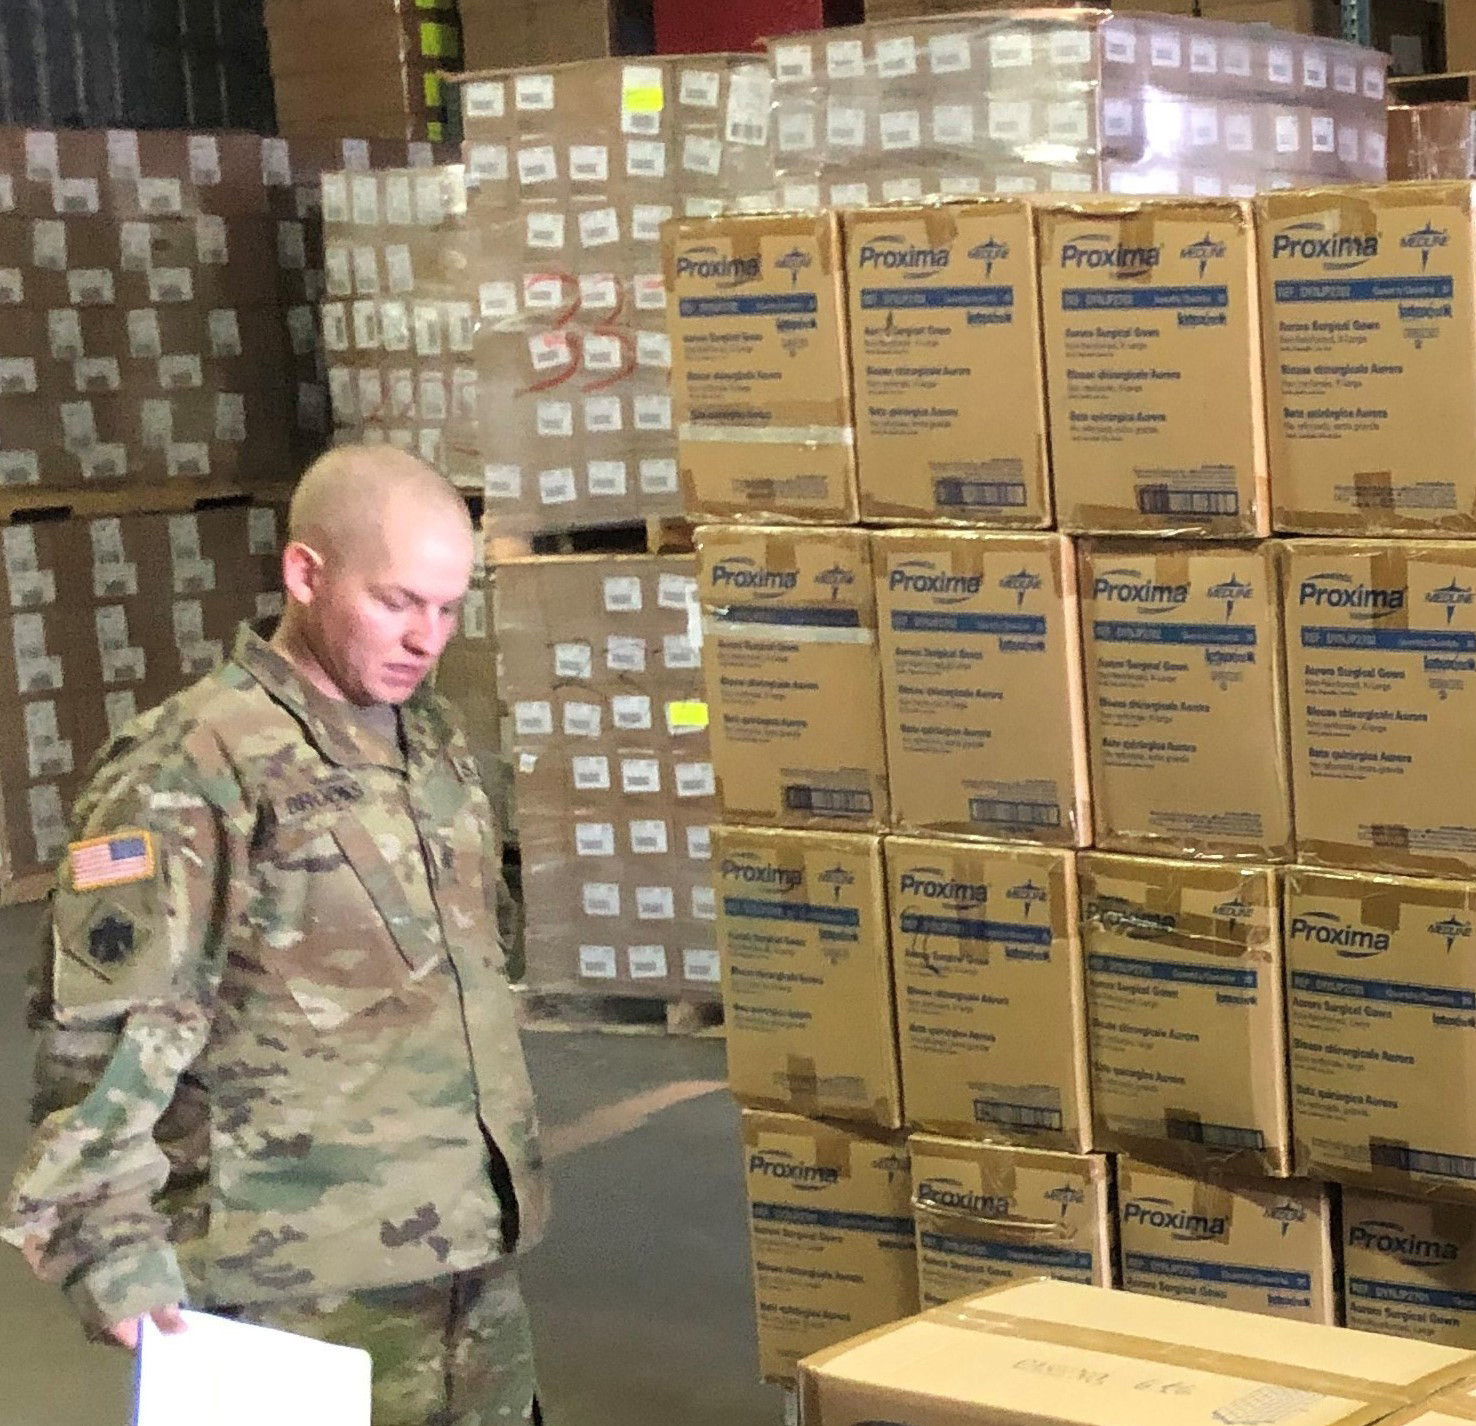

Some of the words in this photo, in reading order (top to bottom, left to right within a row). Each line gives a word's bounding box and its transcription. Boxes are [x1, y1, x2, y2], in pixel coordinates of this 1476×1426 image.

[860, 247, 950, 269] Proxima
[1061, 244, 1160, 268] Proxima
[1273, 227, 1379, 262] Proxima
[712, 565, 797, 589] Proxima
[890, 570, 981, 594] Proxima
[1095, 578, 1189, 603] Proxima
[1299, 582, 1404, 609] Proxima
[902, 874, 987, 901] Proxima
[1291, 918, 1389, 950] Proxima
[750, 1155, 838, 1184] Proxima
[1125, 1202, 1225, 1235] Proxima
[1348, 1226, 1459, 1261] Proxima
